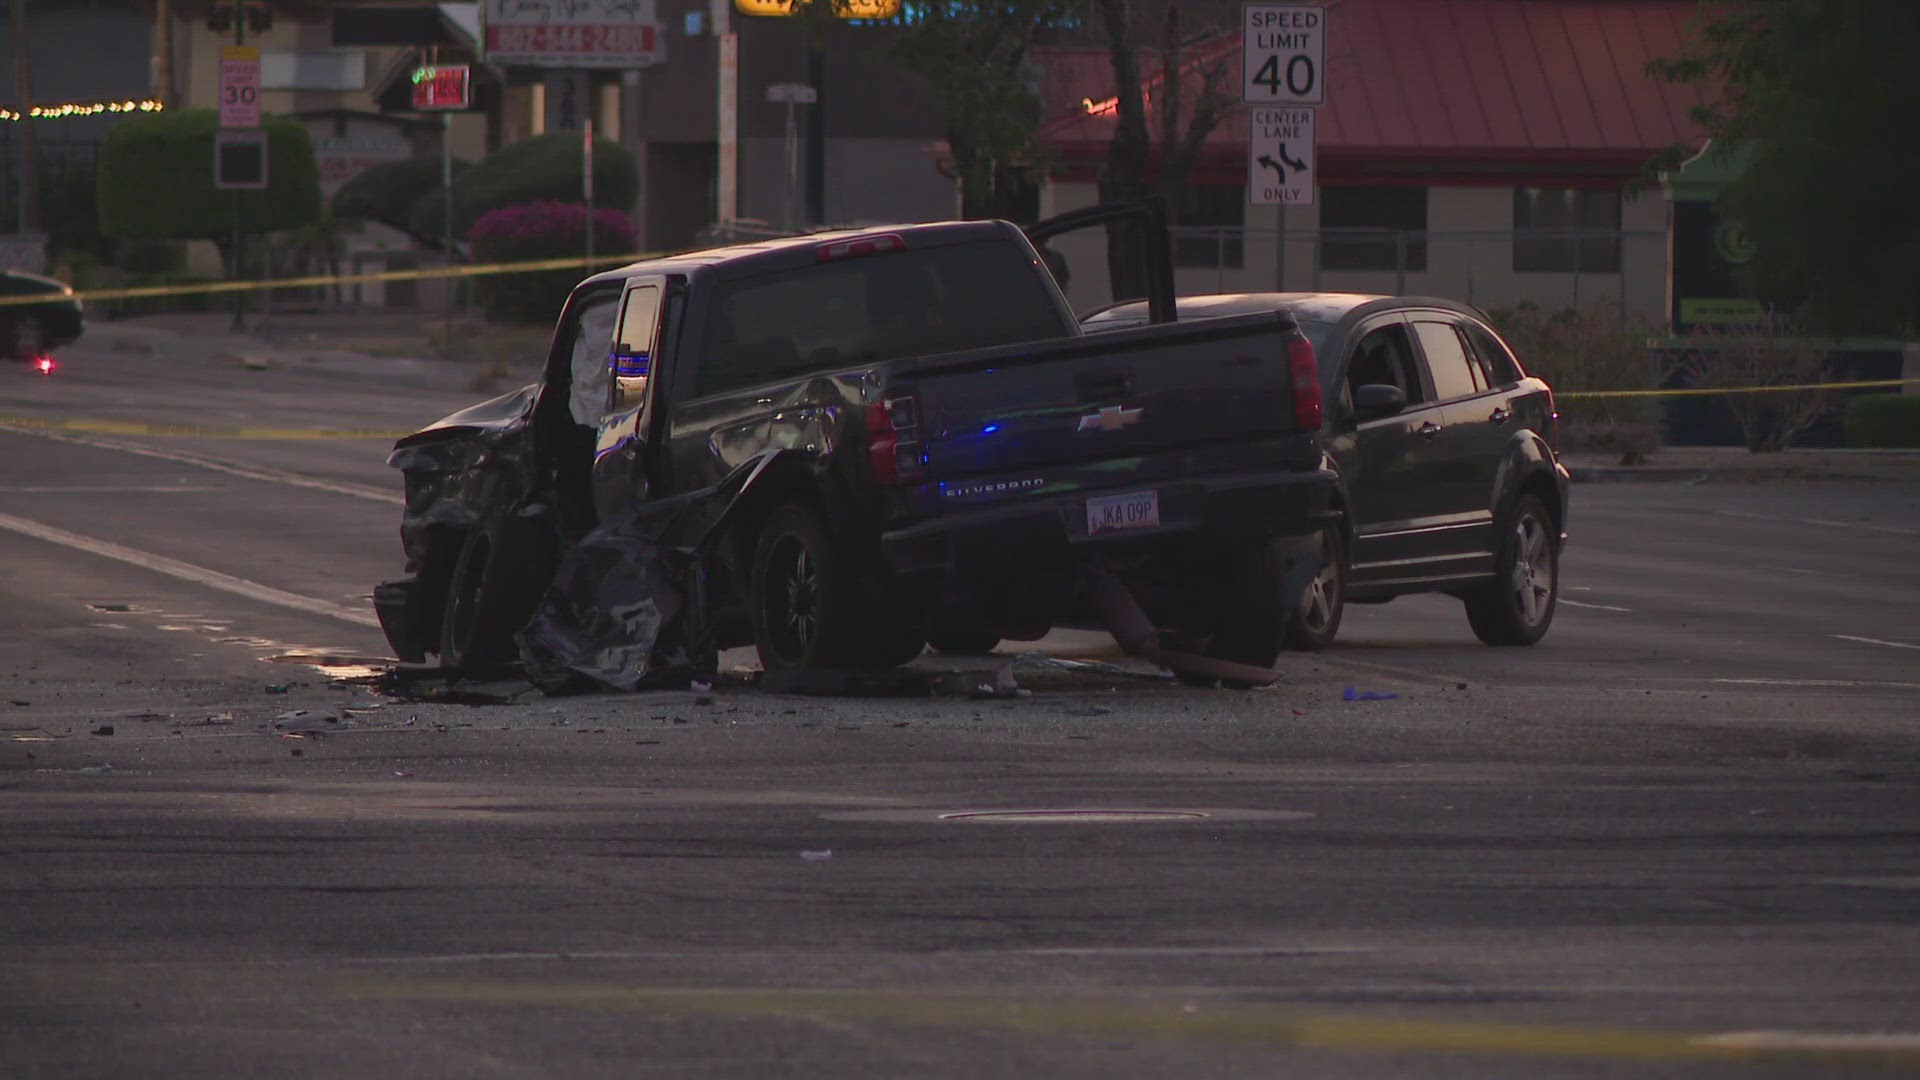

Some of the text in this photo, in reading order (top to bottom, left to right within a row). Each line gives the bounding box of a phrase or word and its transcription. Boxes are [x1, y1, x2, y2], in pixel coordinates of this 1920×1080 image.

[1251, 12, 1318, 28] SPEED
[1258, 33, 1310, 49] LIMIT
[1252, 54, 1315, 96] 40
[225, 85, 257, 104] 30
[1256, 111, 1310, 124] CENTER
[1264, 126, 1301, 138] LANE
[1264, 188, 1301, 201] ONLY
[945, 478, 1044, 497] SILVERADO
[1100, 501, 1152, 526] JKA 09P
